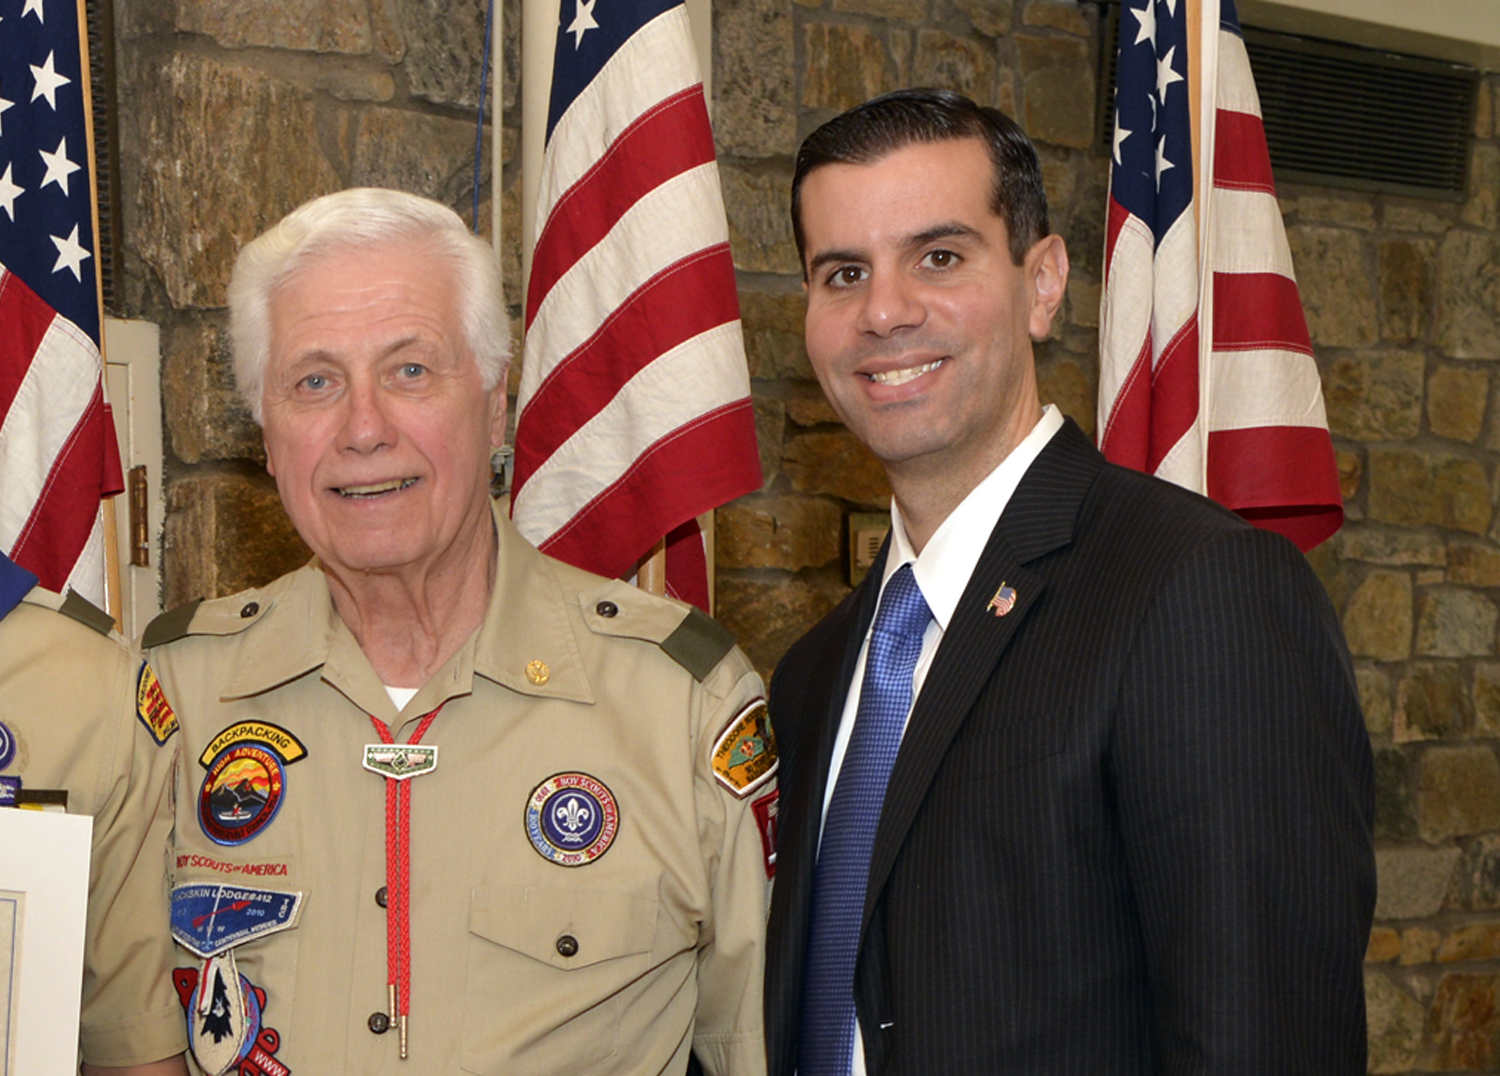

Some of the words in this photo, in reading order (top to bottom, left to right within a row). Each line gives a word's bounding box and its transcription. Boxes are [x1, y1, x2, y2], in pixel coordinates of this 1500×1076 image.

[211, 726, 290, 753] BACKPACKING
[213, 755, 231, 775] HIGH
[234, 748, 279, 775] ADVENTURE
[581, 778, 610, 805] SCOUTS
[190, 855, 233, 873] SCOUTS
[241, 864, 288, 876] AMERICA
